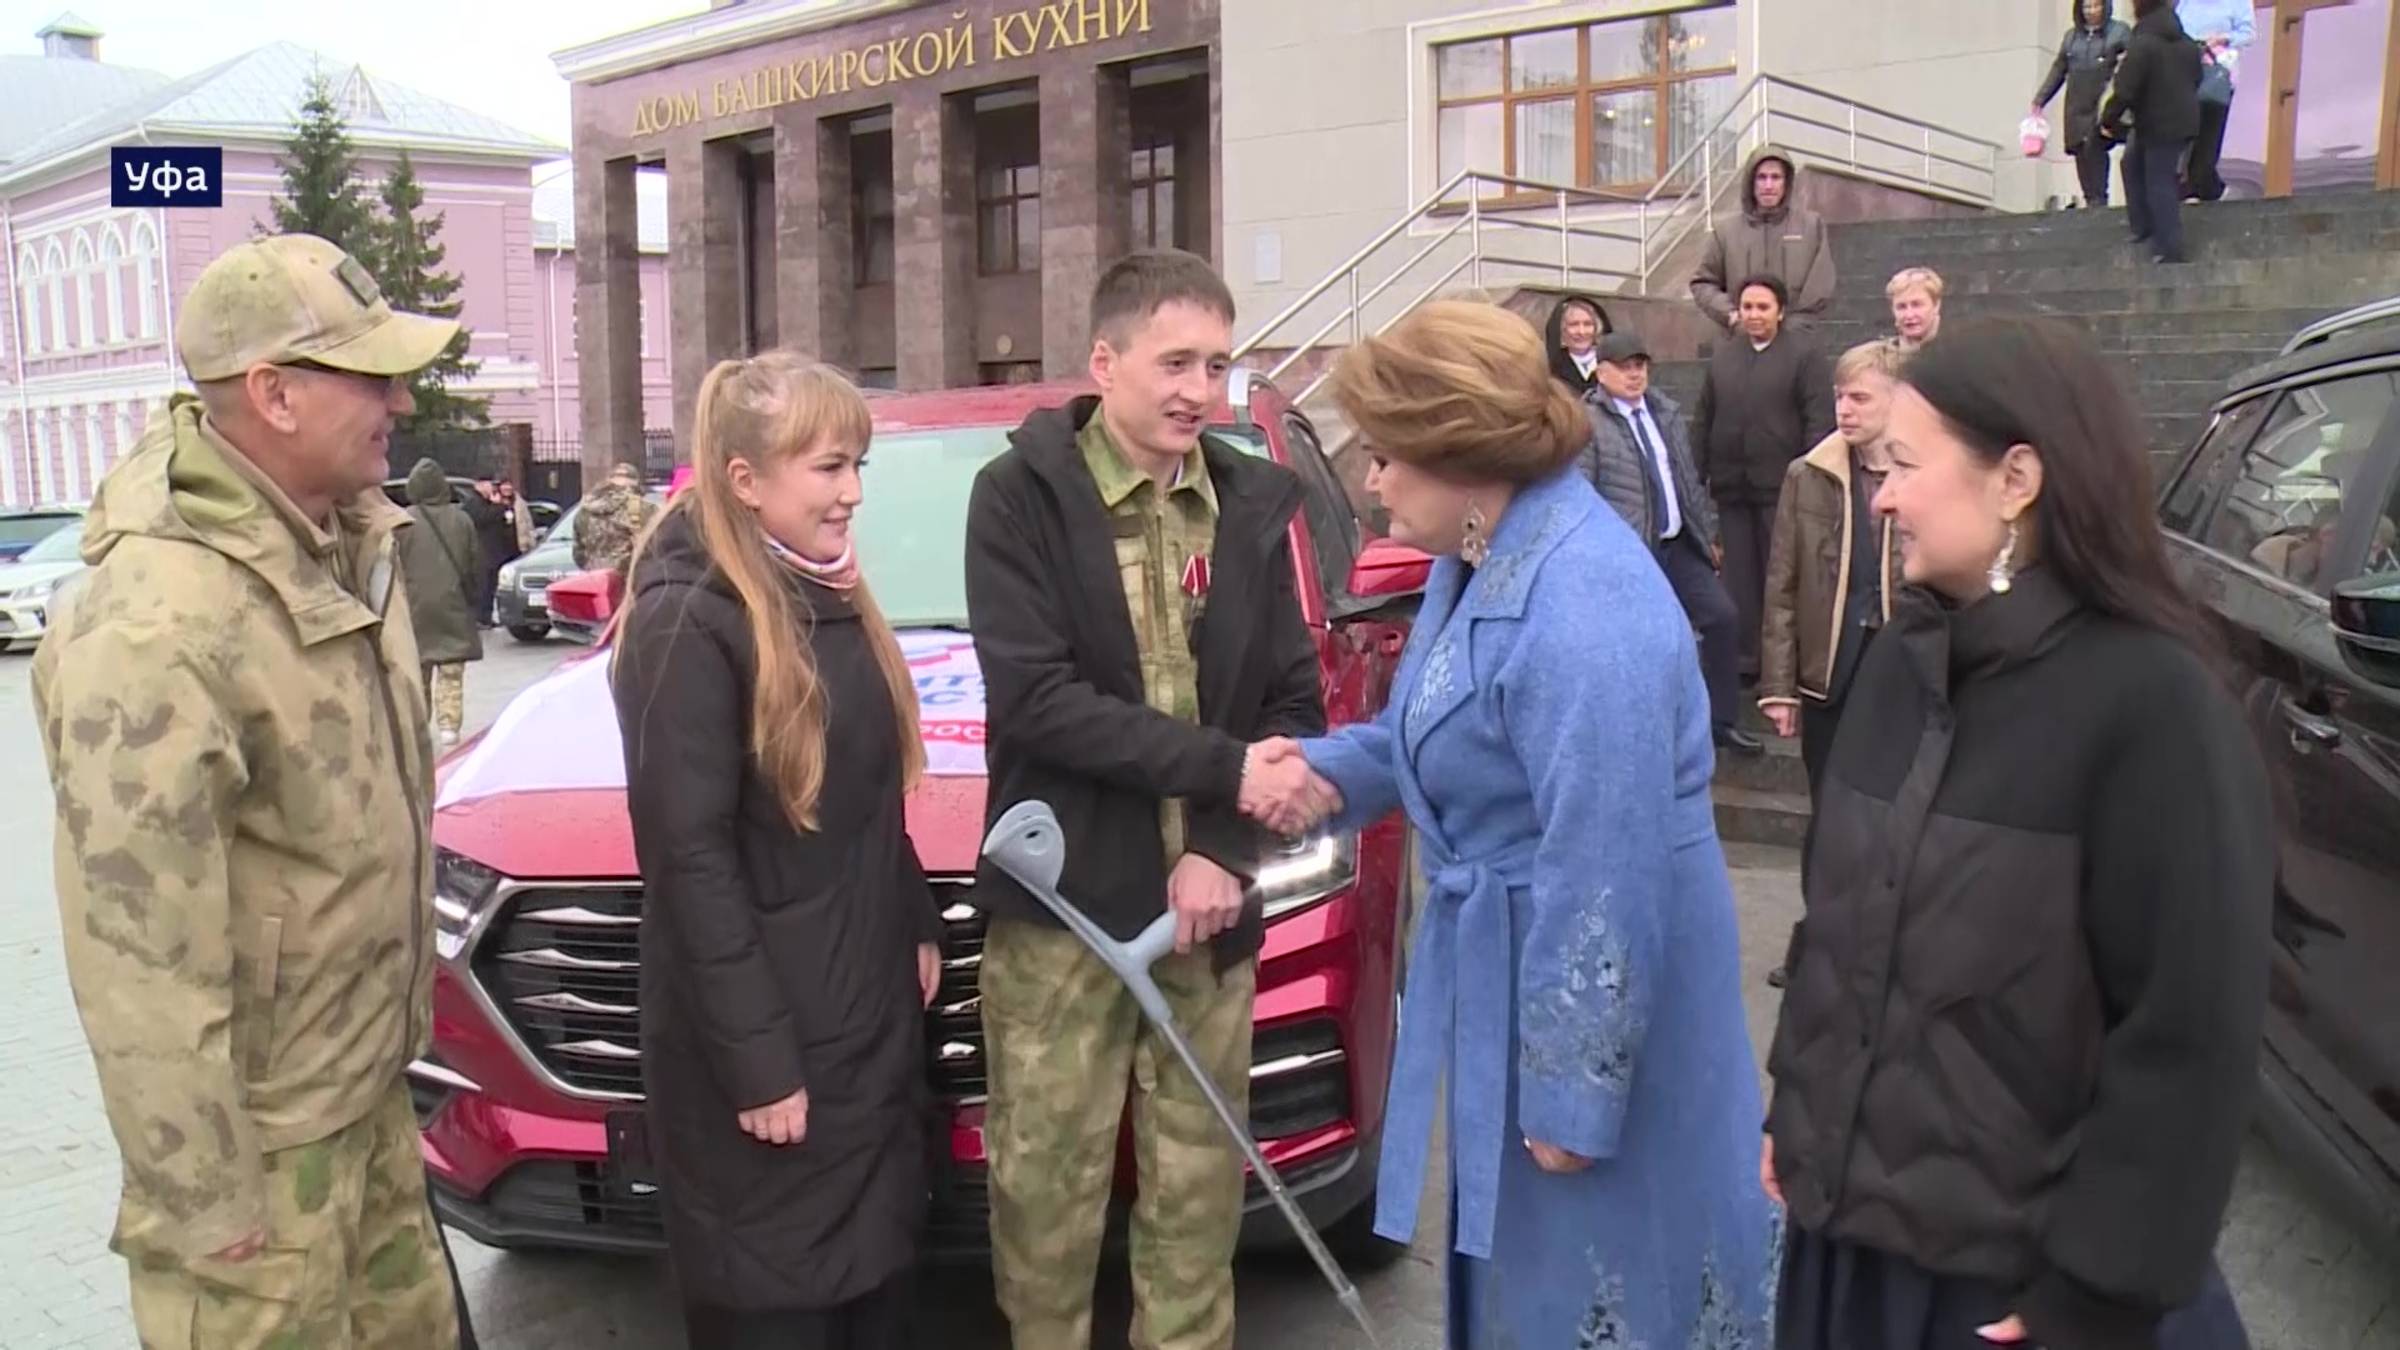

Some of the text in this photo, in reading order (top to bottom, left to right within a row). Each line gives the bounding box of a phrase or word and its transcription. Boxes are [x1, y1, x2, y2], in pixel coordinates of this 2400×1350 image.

[630, 0, 1153, 137] ДОМ БАШКИРСКОЙ КУХНИ
